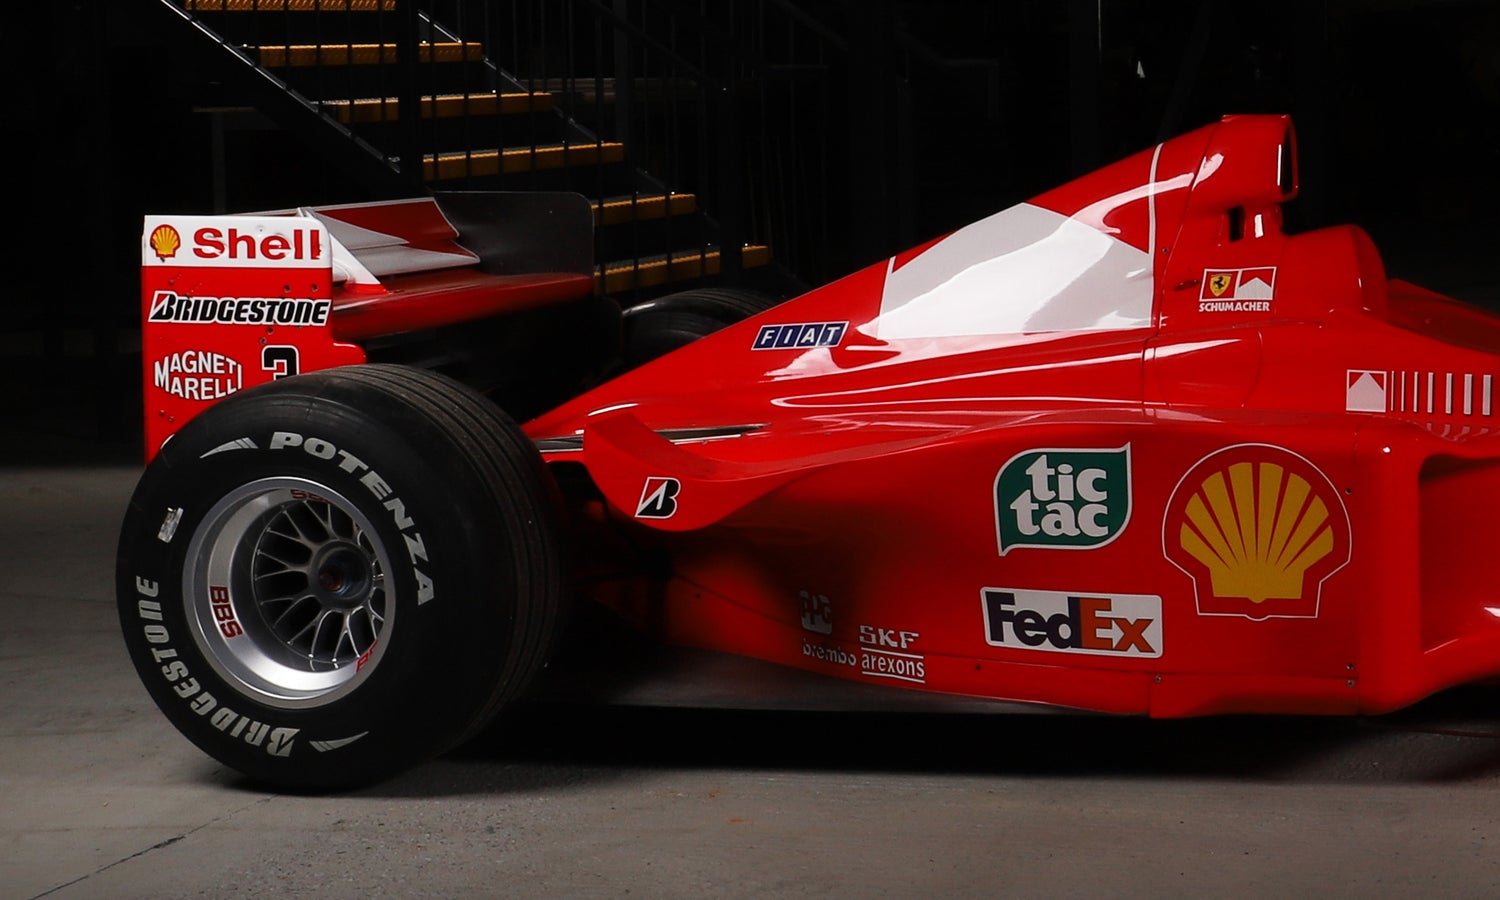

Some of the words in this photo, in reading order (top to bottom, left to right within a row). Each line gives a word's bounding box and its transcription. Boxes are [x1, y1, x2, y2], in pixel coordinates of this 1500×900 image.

[193, 227, 322, 261] Shell
[1199, 302, 1270, 312] SCHUMACHER
[760, 326, 841, 346] FIAT
[155, 351, 242, 380] MAGNETI
[155, 372, 242, 400] MARELLI
[1026, 454, 1108, 502] tic
[269, 431, 434, 605] POTENZA
[1010, 489, 1109, 537] tac
[210, 585, 243, 639] BBS
[985, 591, 1156, 653] FedEx
[860, 625, 919, 649] SKF
[862, 653, 925, 678] arexons
